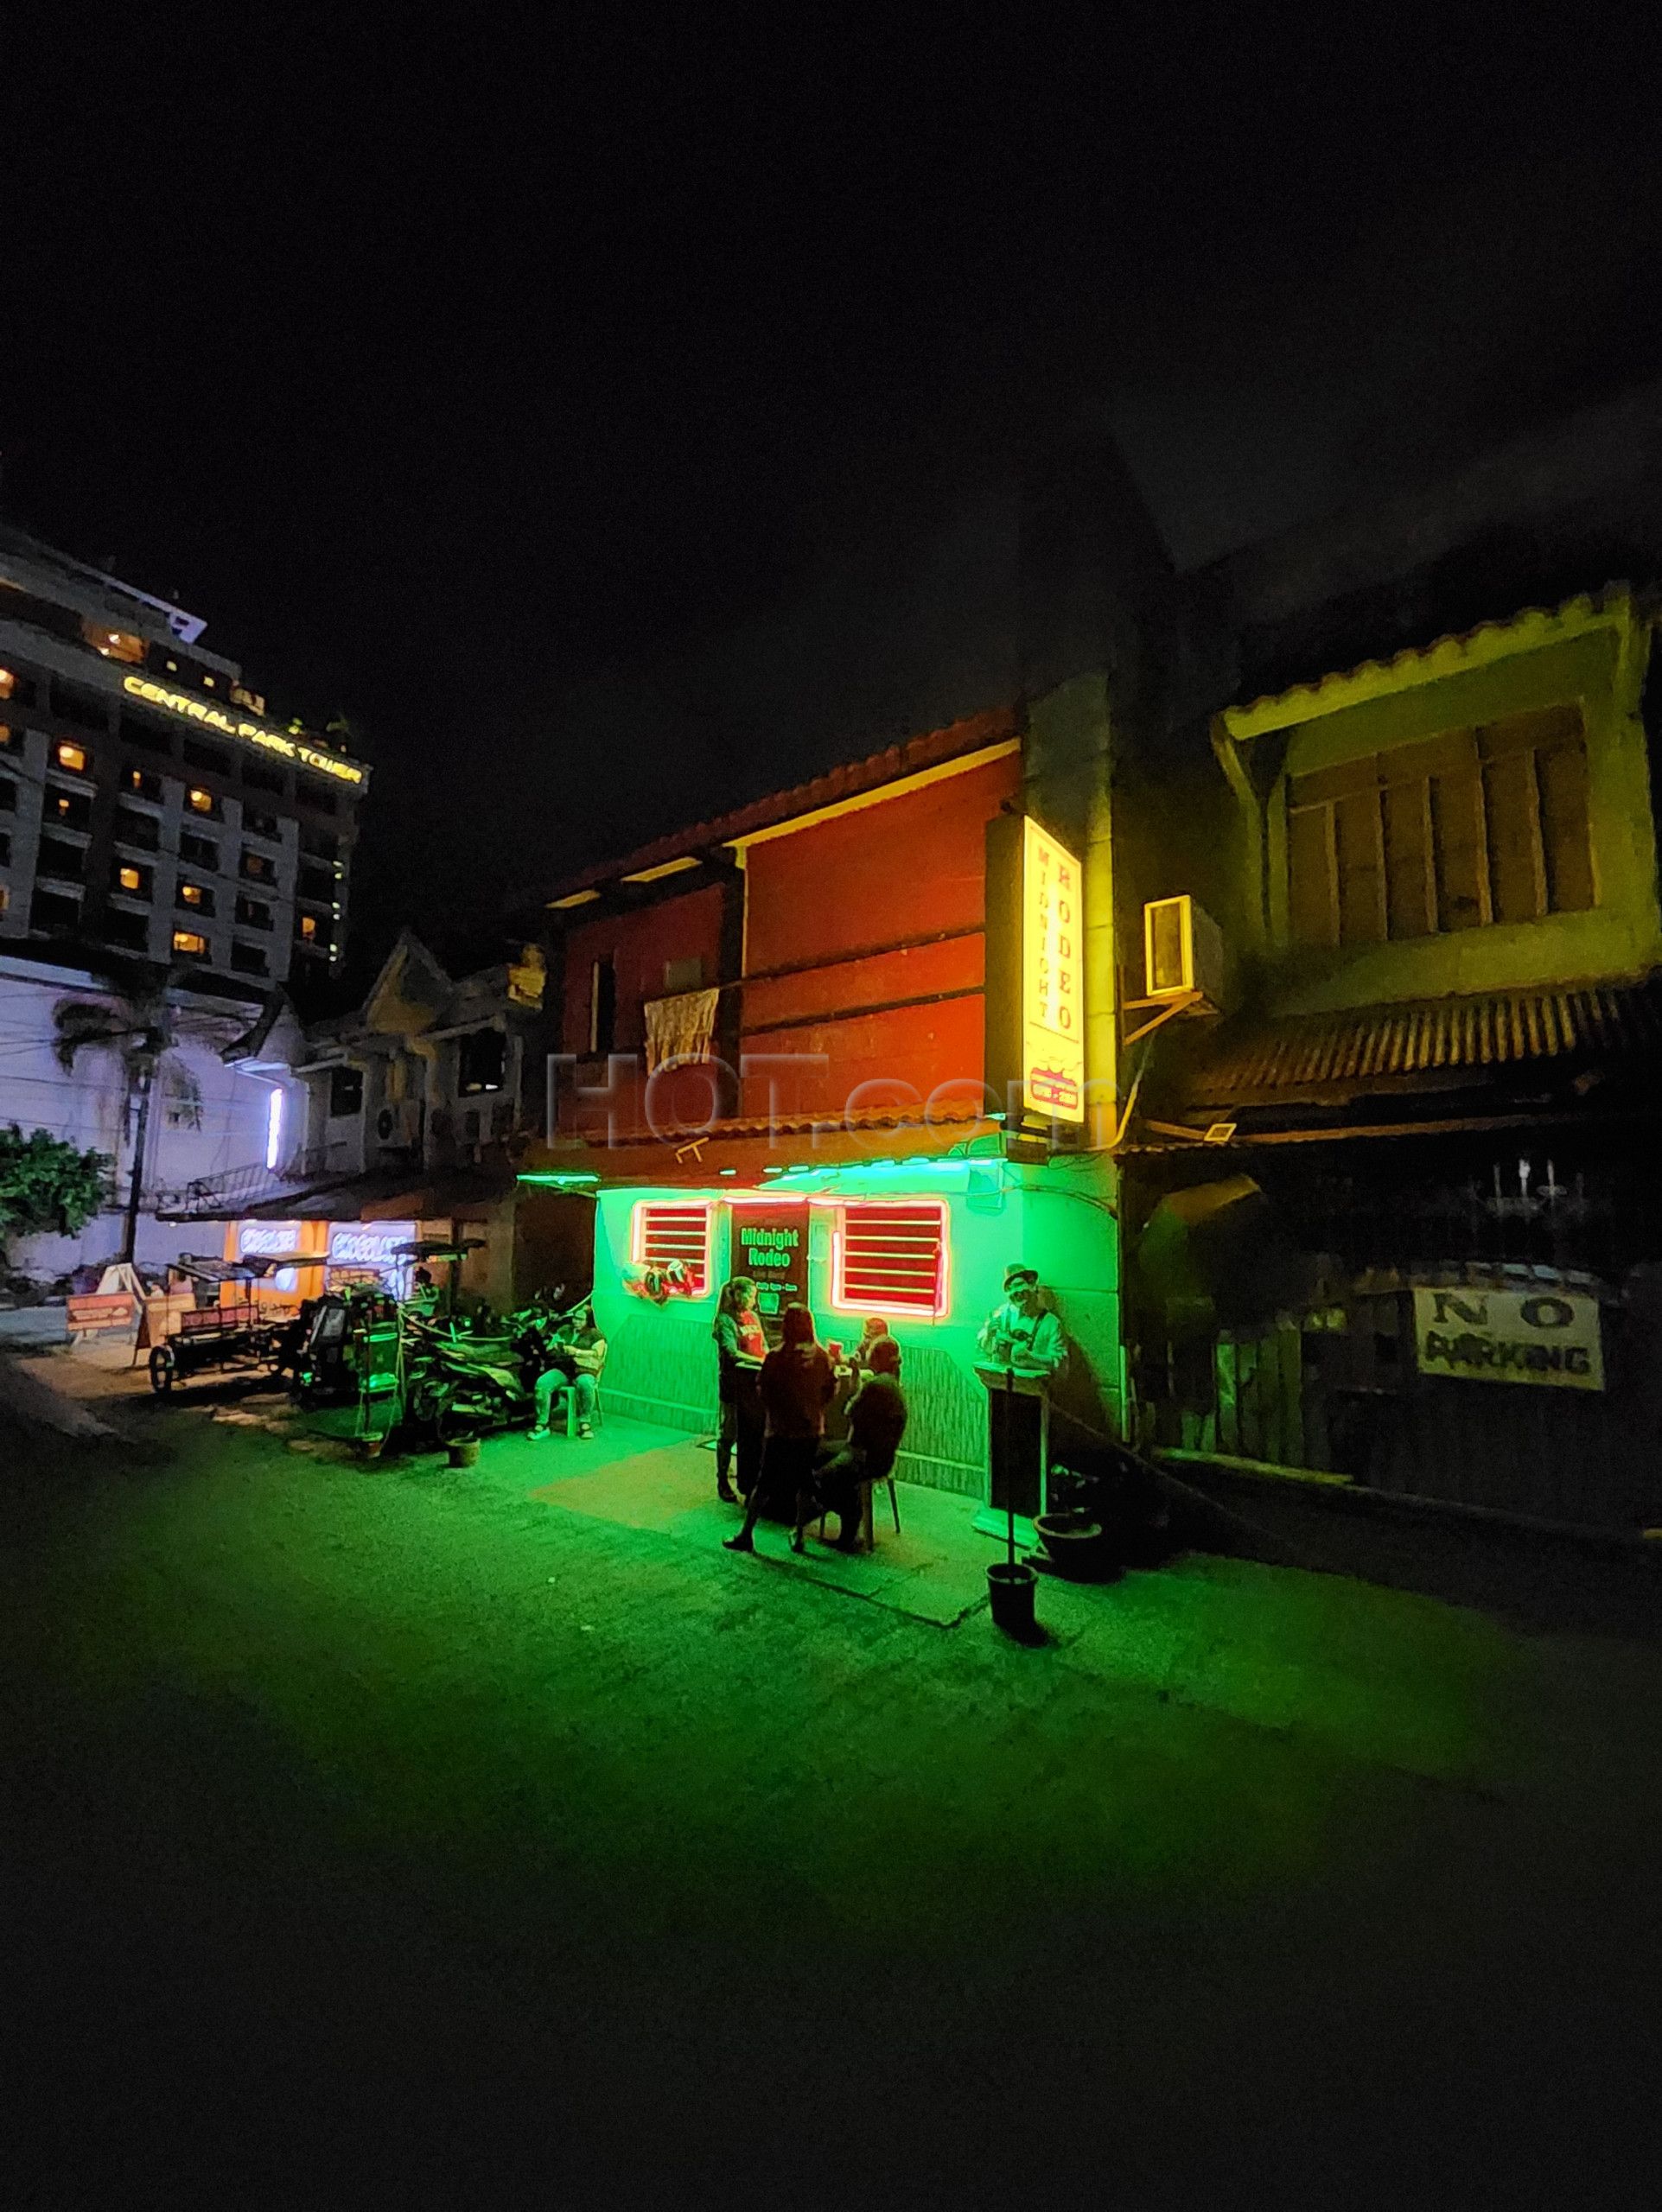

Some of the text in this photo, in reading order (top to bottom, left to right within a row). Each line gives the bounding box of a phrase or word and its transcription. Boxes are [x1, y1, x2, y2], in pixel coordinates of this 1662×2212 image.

[124, 676, 362, 784] CENTRAL PARK TOWER
[1059, 864, 1071, 1029] RODEO
[741, 1228, 799, 1250] Midnight
[748, 1248, 791, 1268] Rodeo
[1433, 1293, 1575, 1328] NO
